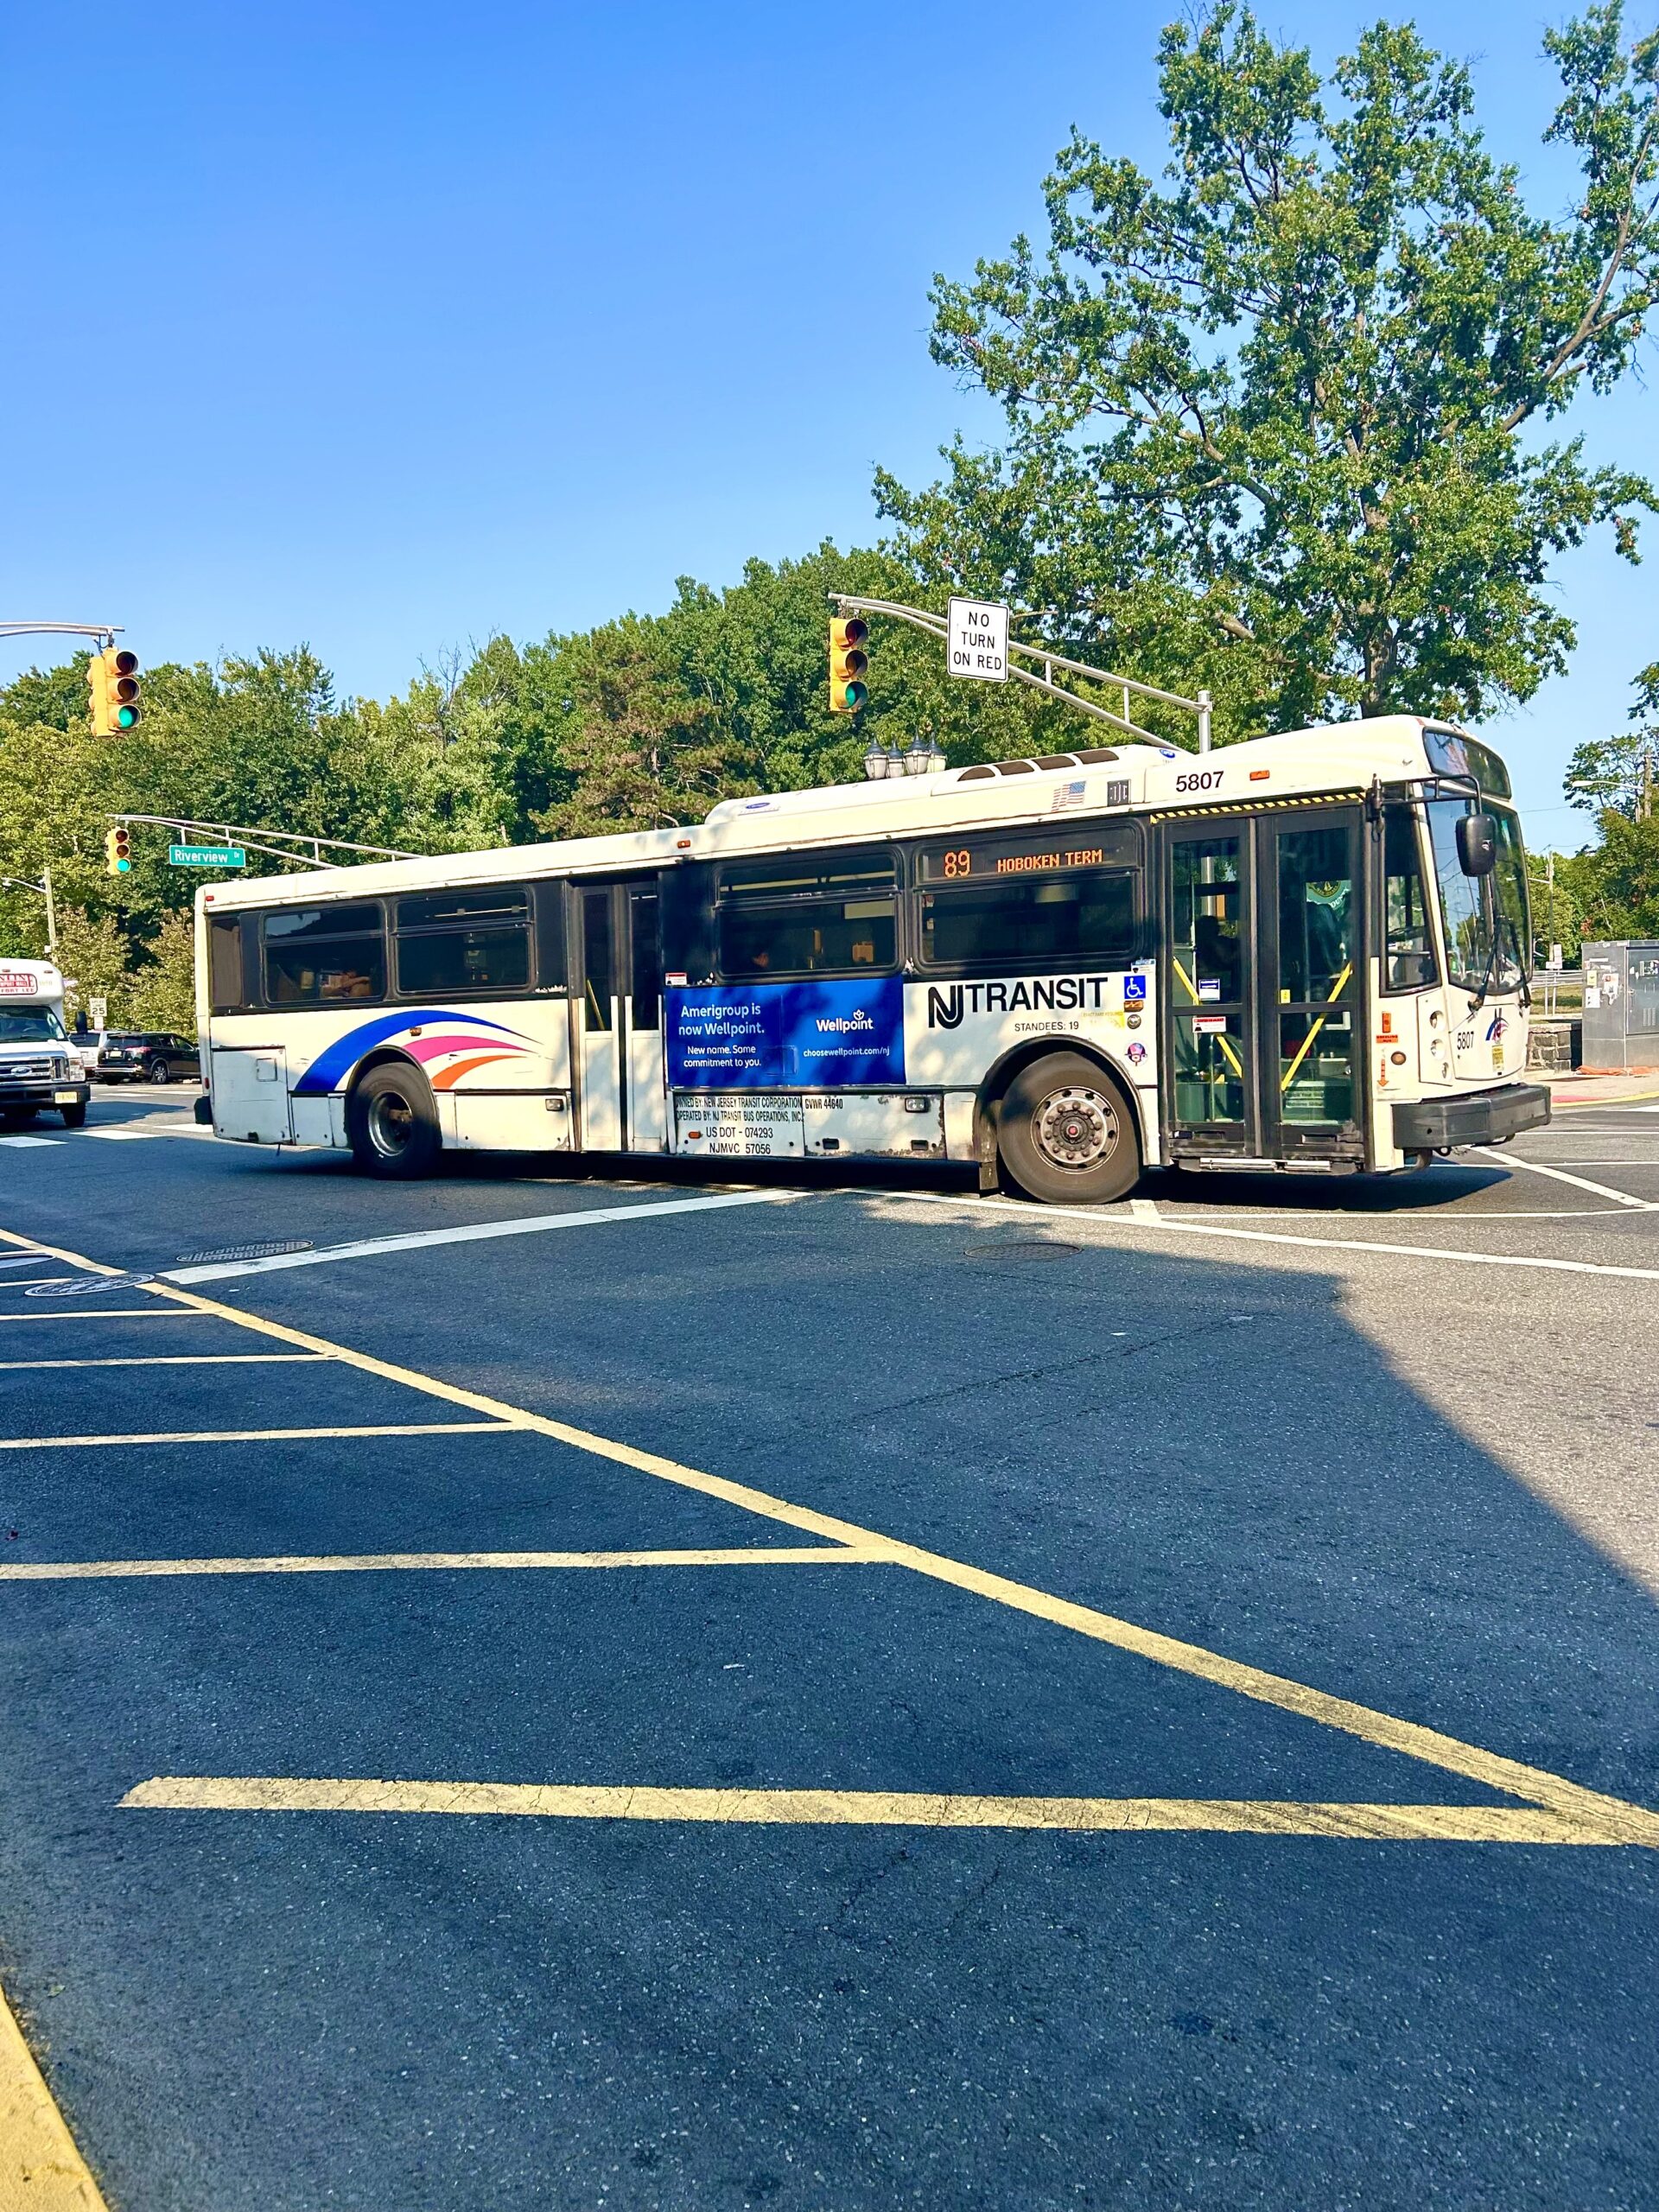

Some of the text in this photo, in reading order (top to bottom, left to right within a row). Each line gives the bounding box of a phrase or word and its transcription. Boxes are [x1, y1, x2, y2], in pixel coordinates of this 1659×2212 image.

[968, 611, 989, 627] NO
[961, 631, 995, 649] TURN
[953, 651, 1002, 671] ON RED
[1175, 770, 1224, 792] 5807
[175, 849, 228, 863] Riverview
[944, 849, 970, 878] 89
[997, 849, 1103, 873] HOBOKEN TERM
[681, 1002, 761, 1020] Amerigroup is
[928, 976, 1109, 1030] NJ TRANSIT
[678, 1021, 765, 1038] now Wellpoint.
[816, 1017, 874, 1034] Wellpoint
[1014, 1020, 1079, 1033] STANDEES: 19
[1457, 1031, 1474, 1051] 5807
[687, 1044, 756, 1055] New name. Same
[803, 1046, 890, 1057] choosewellpoint.com/nj
[683, 1058, 761, 1069] commitment to you.
[704, 1096, 715, 1108] NEW
[716, 1096, 737, 1108] JERSEY
[738, 1096, 761, 1108] TRANSIT
[761, 1096, 802, 1109] CORPORATION
[804, 1098, 823, 1109] GVWR
[677, 1110, 803, 1123] OPERATED BY: NJ TRANSIT BUS OPERATIONS, INC.
[705, 1127, 718, 1138] US
[719, 1127, 736, 1138] DOT
[745, 1127, 773, 1139] 074293
[709, 1142, 771, 1154] NJMVC 57056
